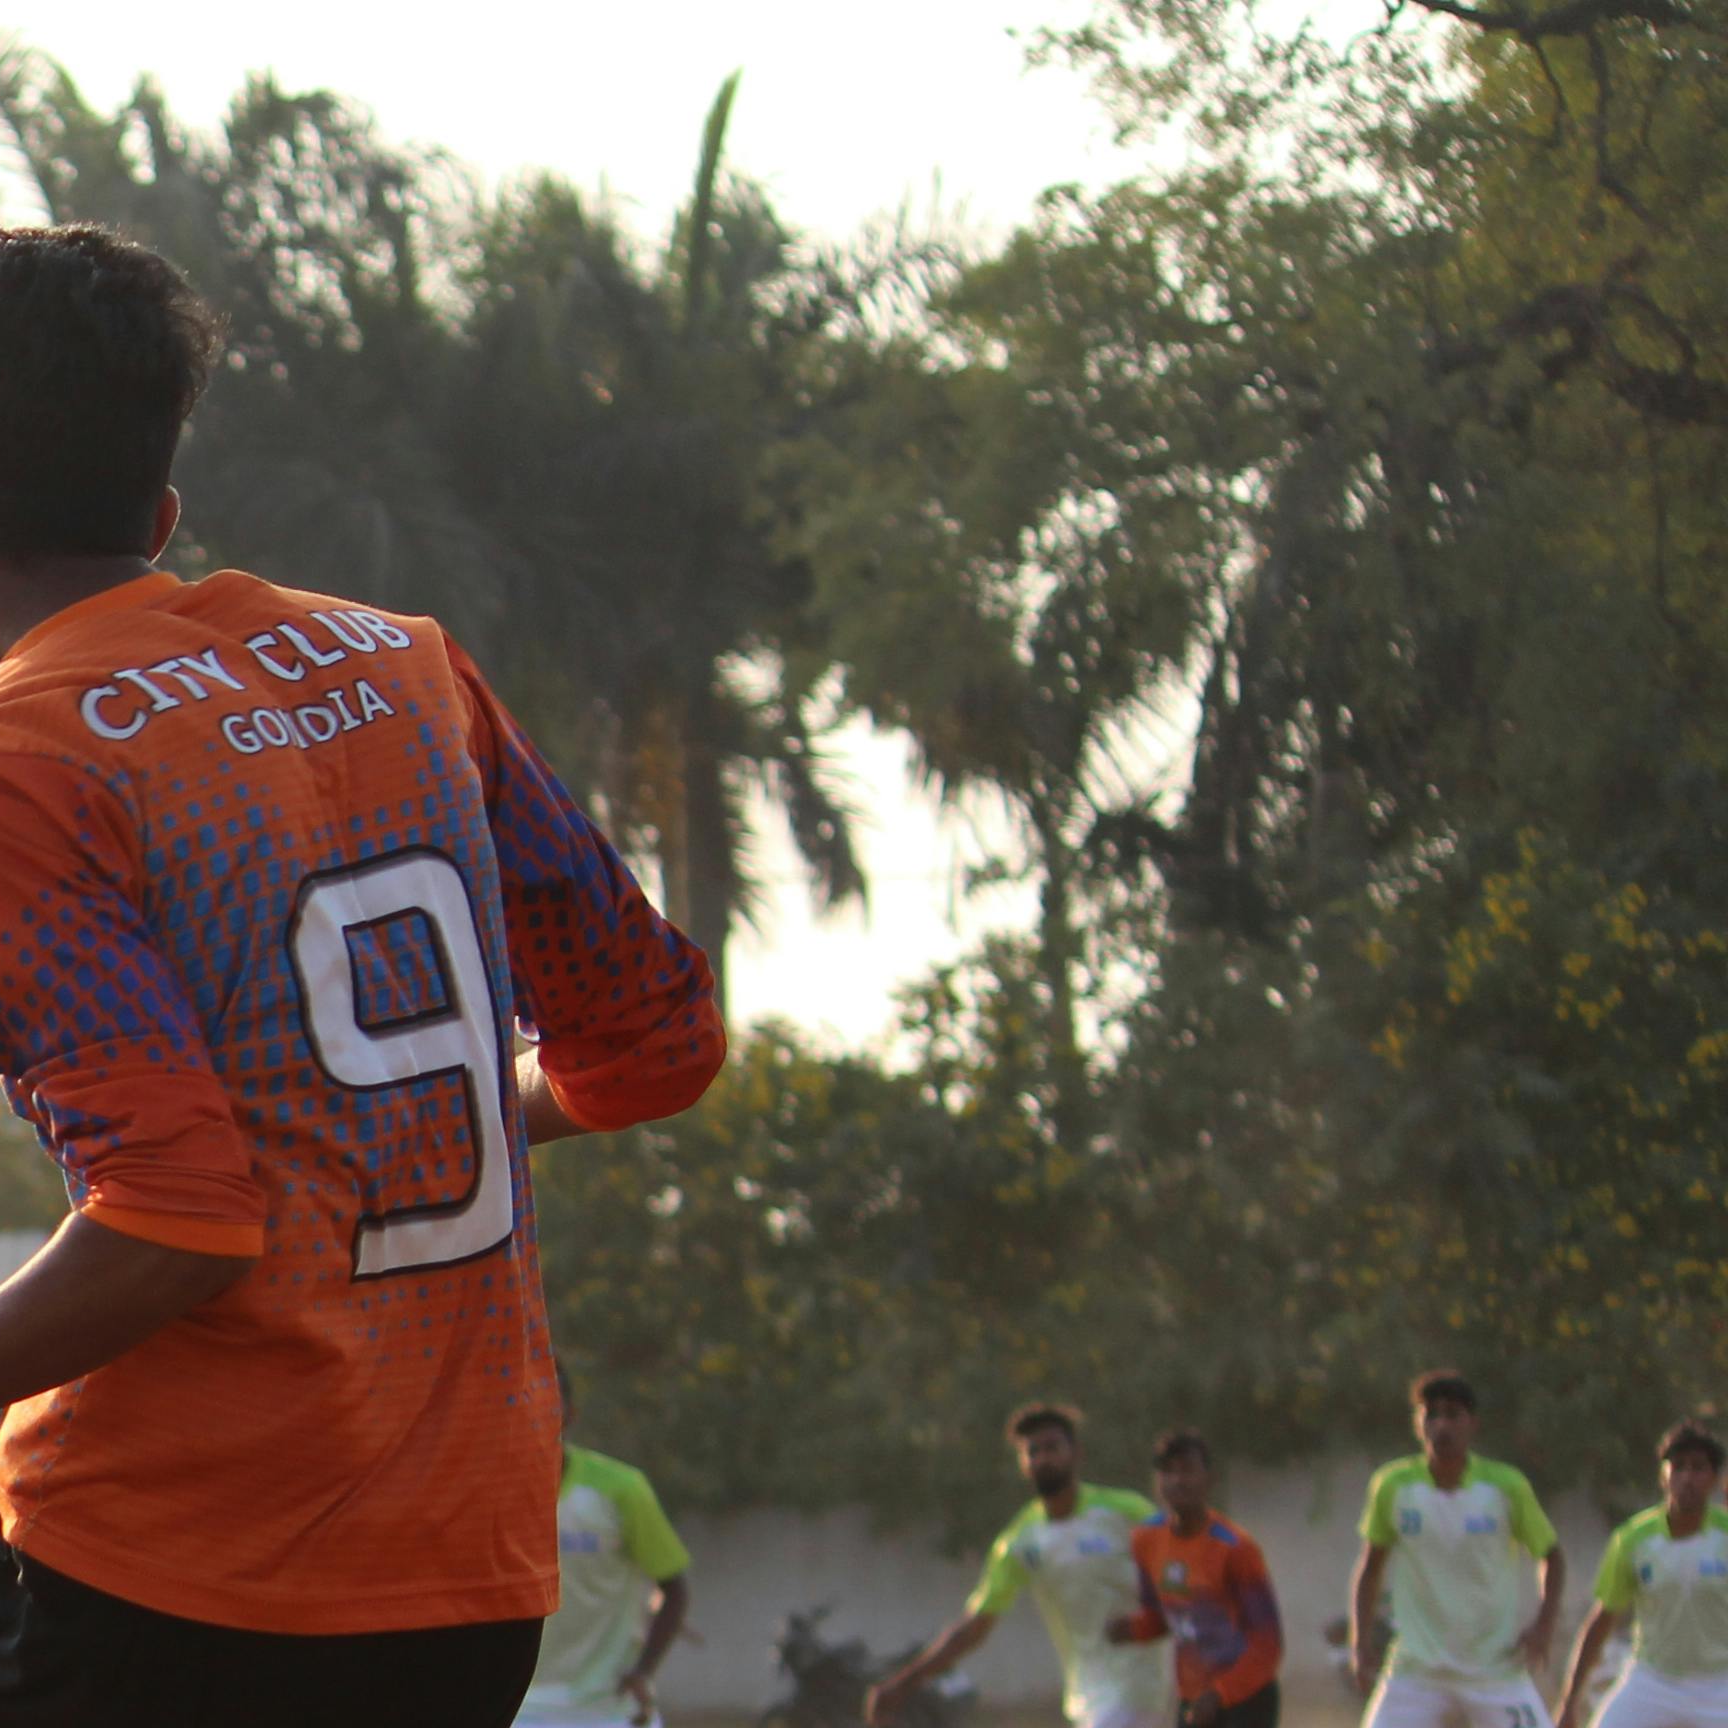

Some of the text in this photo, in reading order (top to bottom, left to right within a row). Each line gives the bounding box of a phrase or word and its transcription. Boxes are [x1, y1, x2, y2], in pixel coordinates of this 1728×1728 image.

[77, 609, 412, 741] CITY CLUB
[287, 845, 514, 1280] 9
